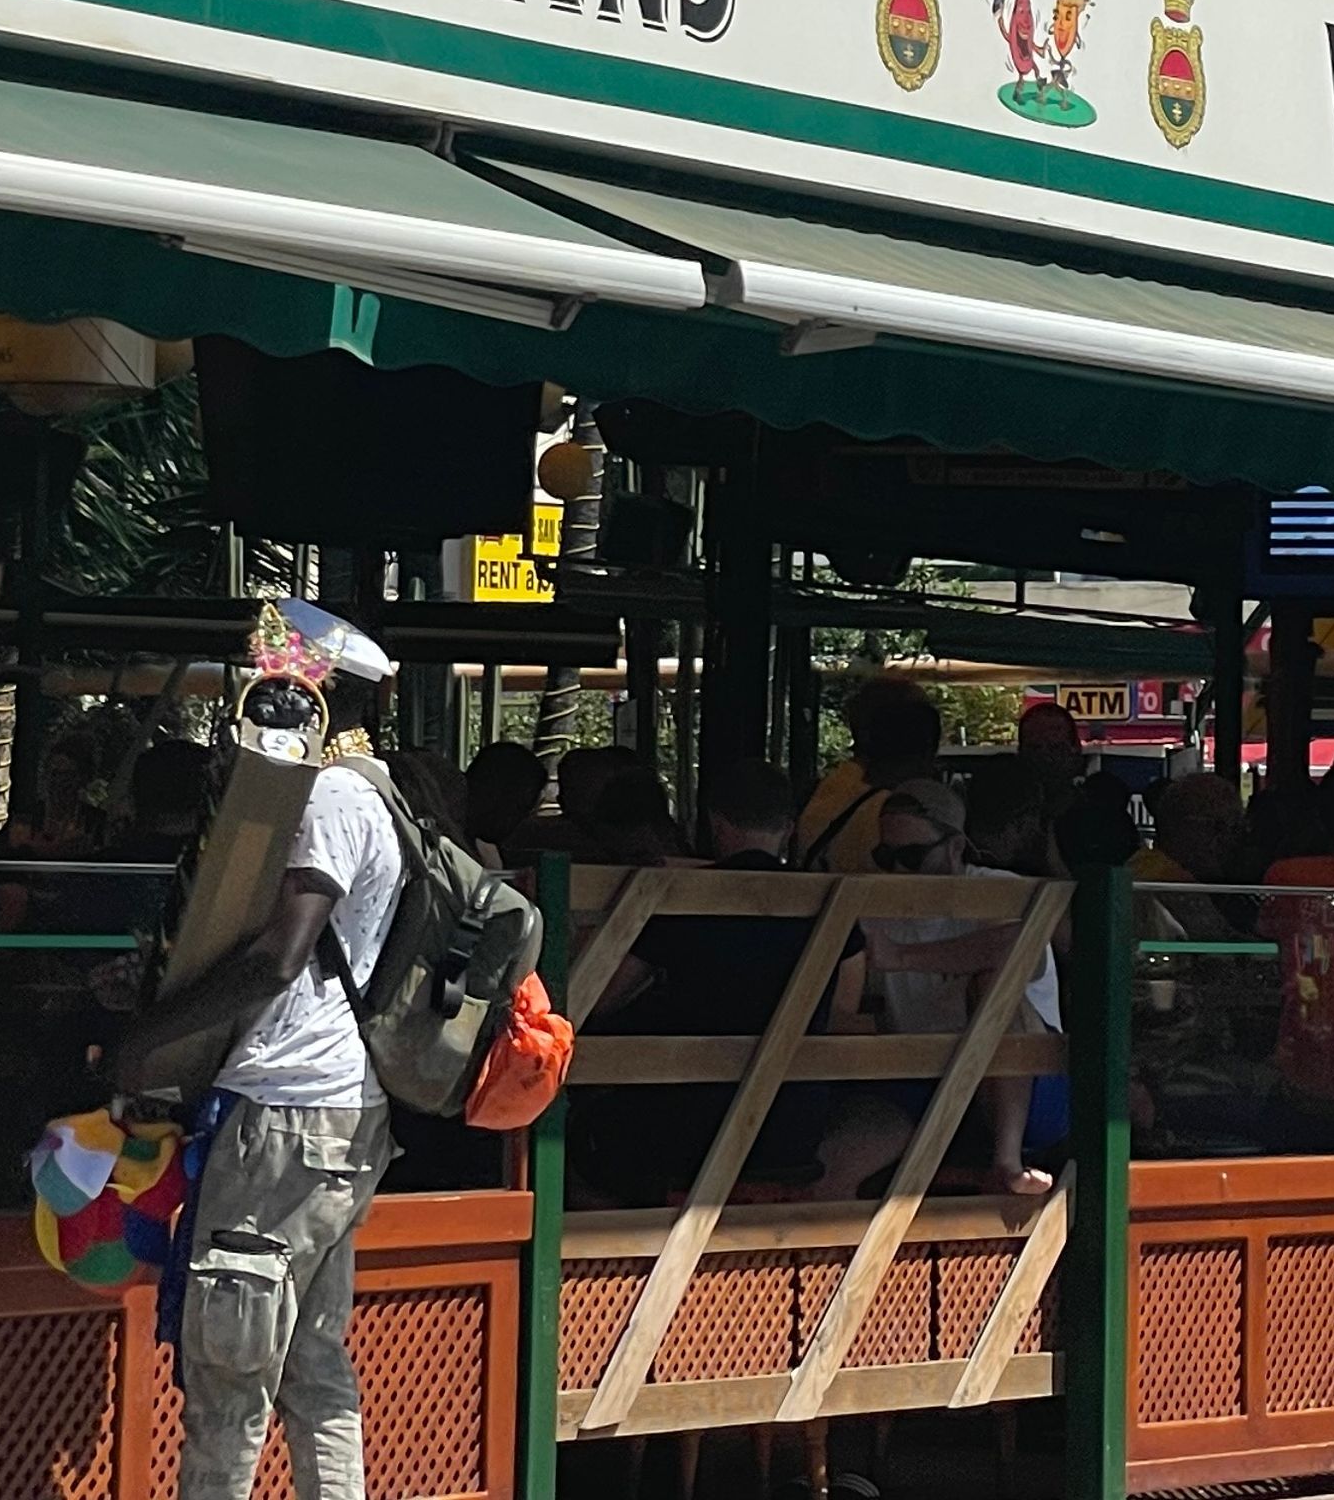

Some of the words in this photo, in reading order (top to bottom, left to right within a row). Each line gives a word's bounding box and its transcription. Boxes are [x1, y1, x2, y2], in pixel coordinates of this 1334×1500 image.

[478, 560, 521, 590] RENT
[526, 570, 534, 591] a
[1066, 691, 1124, 715] ATM
